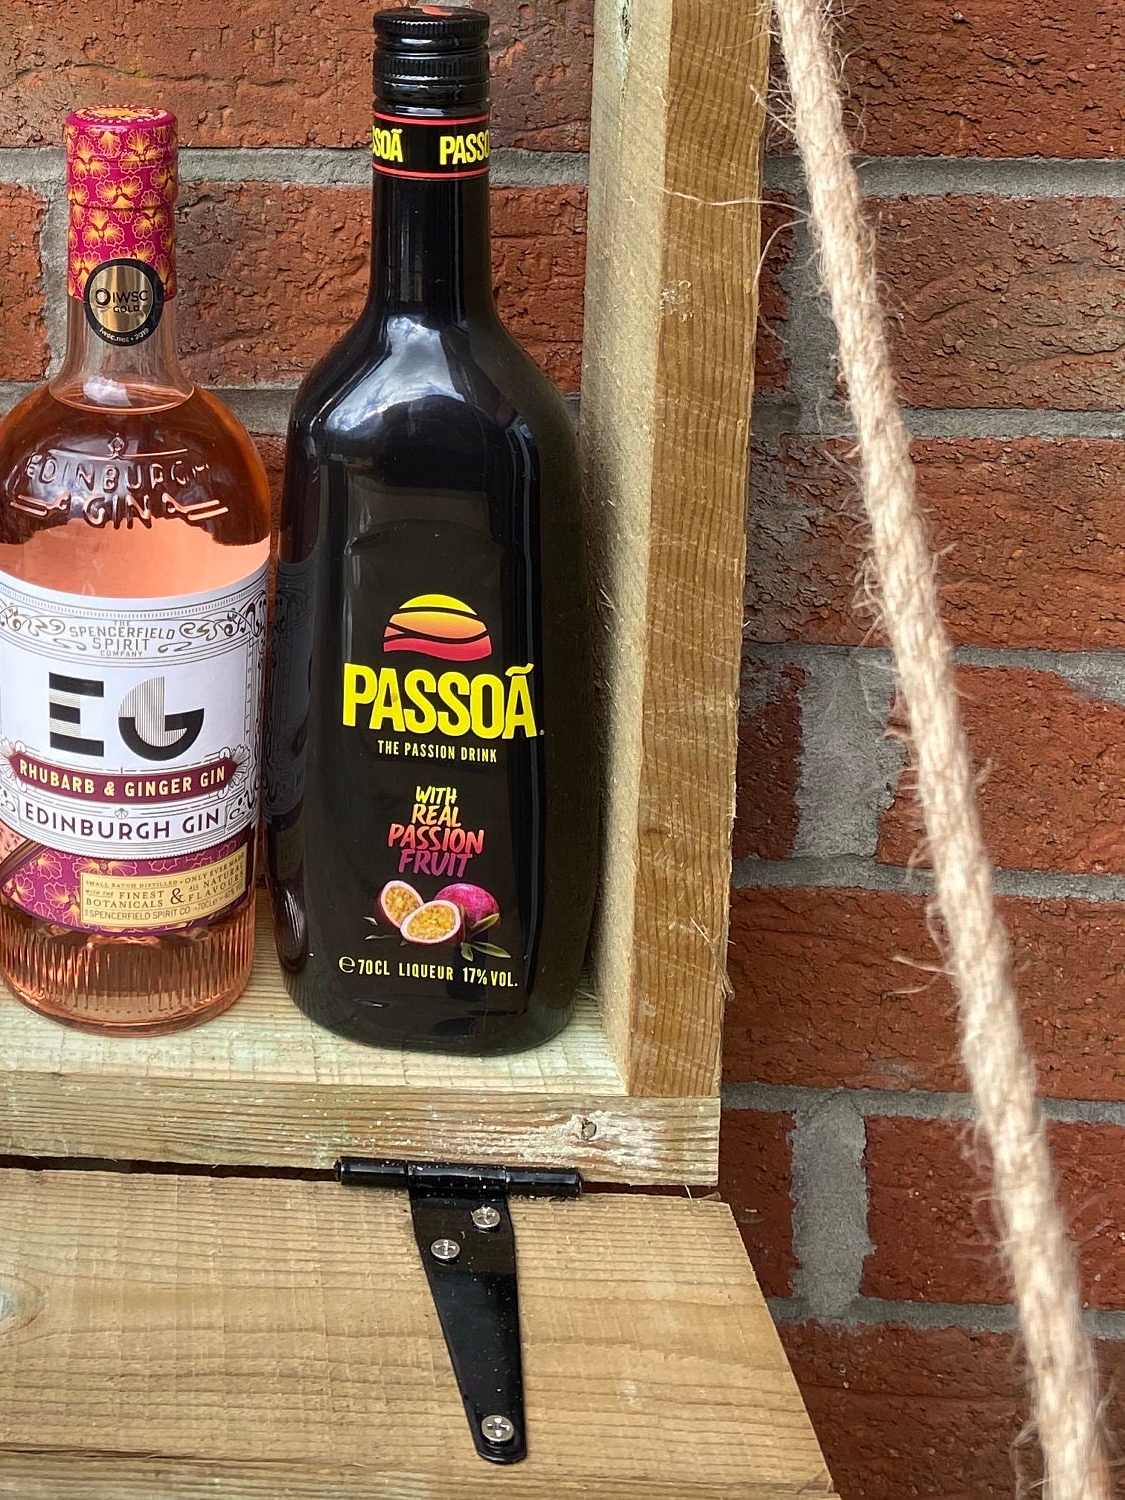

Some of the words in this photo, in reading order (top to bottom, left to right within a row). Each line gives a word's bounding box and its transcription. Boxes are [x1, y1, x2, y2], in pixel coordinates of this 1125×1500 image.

[113, 290, 148, 303] IWSC
[113, 305, 140, 313] GOLD
[135, 327, 149, 340] 2019
[83, 493, 153, 530] GIN
[69, 626, 175, 639] SPENCERFIELD
[92, 637, 150, 651] SPIRIT
[343, 662, 538, 739] PASSOÃ
[49, 672, 205, 762] EG
[377, 739, 399, 755] THE
[404, 742, 455, 760] PASSION
[461, 747, 497, 763] DRINK
[19, 759, 94, 794] RHUBARB
[104, 781, 115, 797] &
[125, 777, 192, 797] GINGER
[200, 766, 225, 788] GIN
[416, 785, 457, 806] WITH
[25, 802, 170, 840] EDINBURGH
[182, 808, 219, 834] GIN
[411, 803, 462, 827] REAL
[388, 823, 484, 854] PASSION
[203, 861, 243, 888] NATURAL
[398, 848, 473, 878] FRUIT
[185, 873, 208, 884] ONLY
[189, 870, 244, 902] FLAVOURS
[86, 898, 163, 909] BOTANICALS
[119, 890, 165, 899] FINEST
[170, 888, 184, 904] &
[89, 909, 151, 920] SPENCERFIELD
[152, 909, 176, 919] SPIRIT
[180, 906, 191, 915] CO
[399, 962, 454, 981] LIQUEUR
[463, 966, 488, 985] 17%
[490, 971, 518, 987] VOL.
